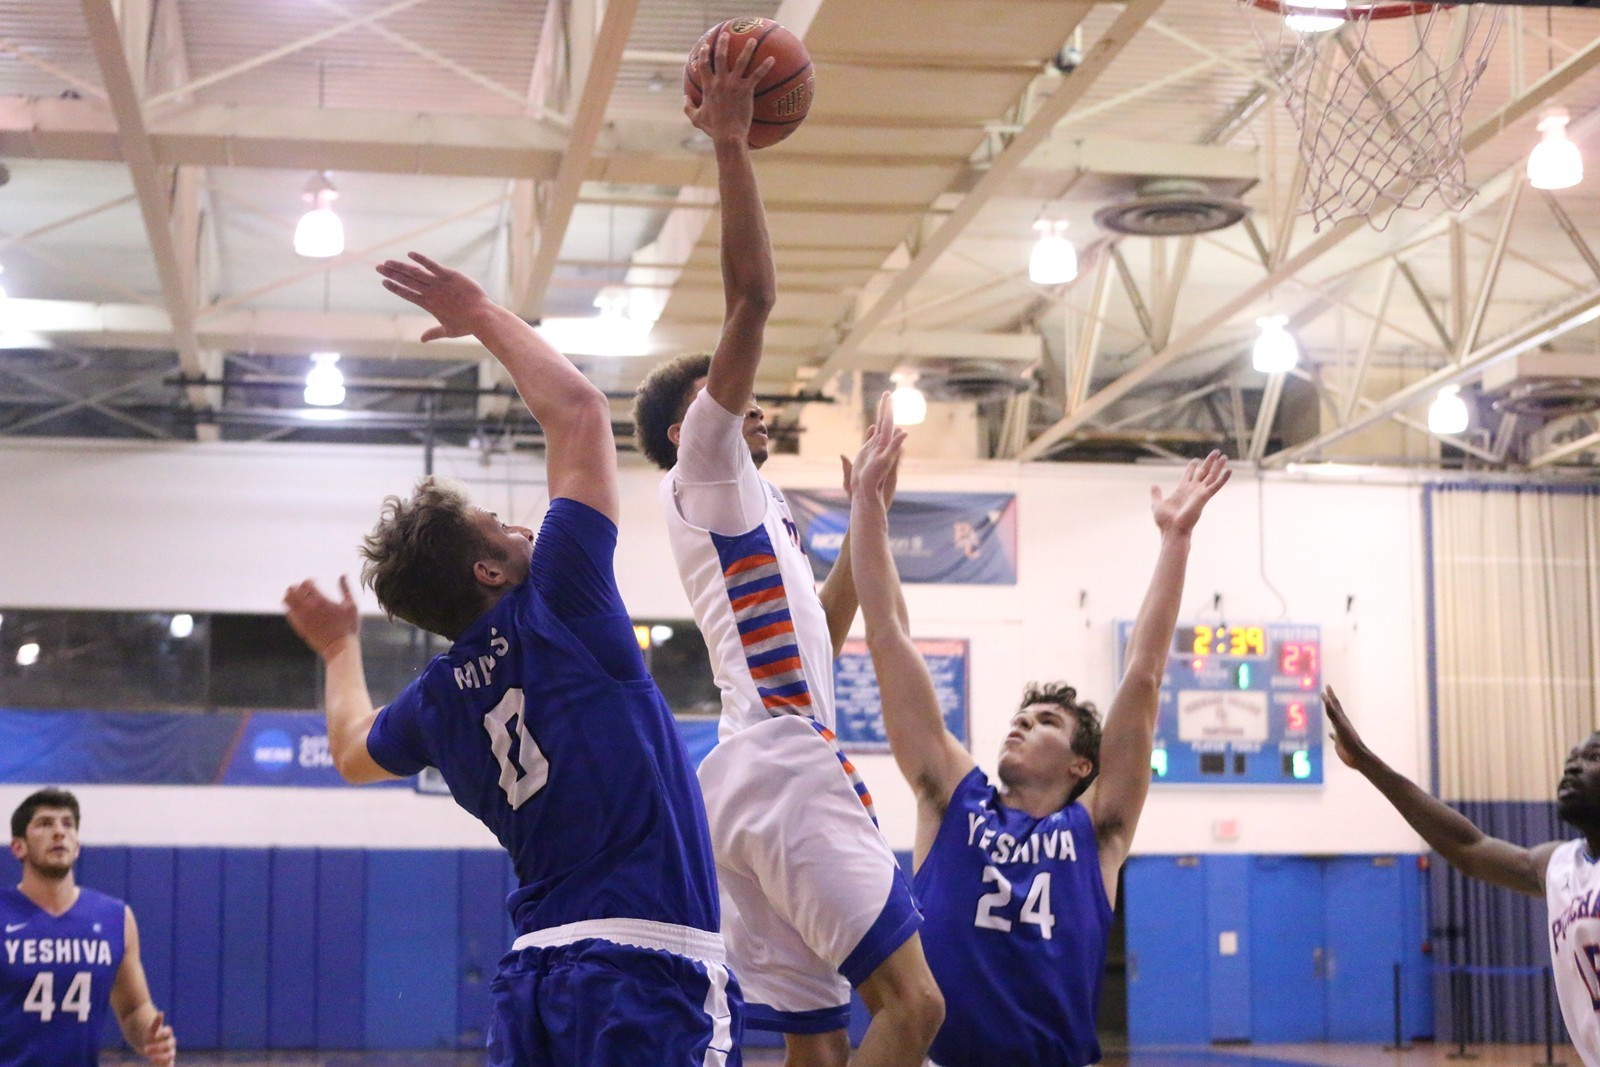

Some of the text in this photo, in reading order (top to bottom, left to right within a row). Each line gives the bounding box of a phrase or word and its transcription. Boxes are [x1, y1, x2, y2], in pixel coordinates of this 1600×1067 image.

[1193, 625, 1265, 656] 2:39
[1281, 642, 1318, 675] 27
[1238, 662, 1250, 690] 1
[1286, 701, 1307, 731] 5
[483, 687, 549, 810] 0
[1292, 750, 1311, 779] 6
[974, 865, 1056, 940] 24
[4, 938, 112, 965] YESHIVA
[23, 971, 92, 1022] 44
